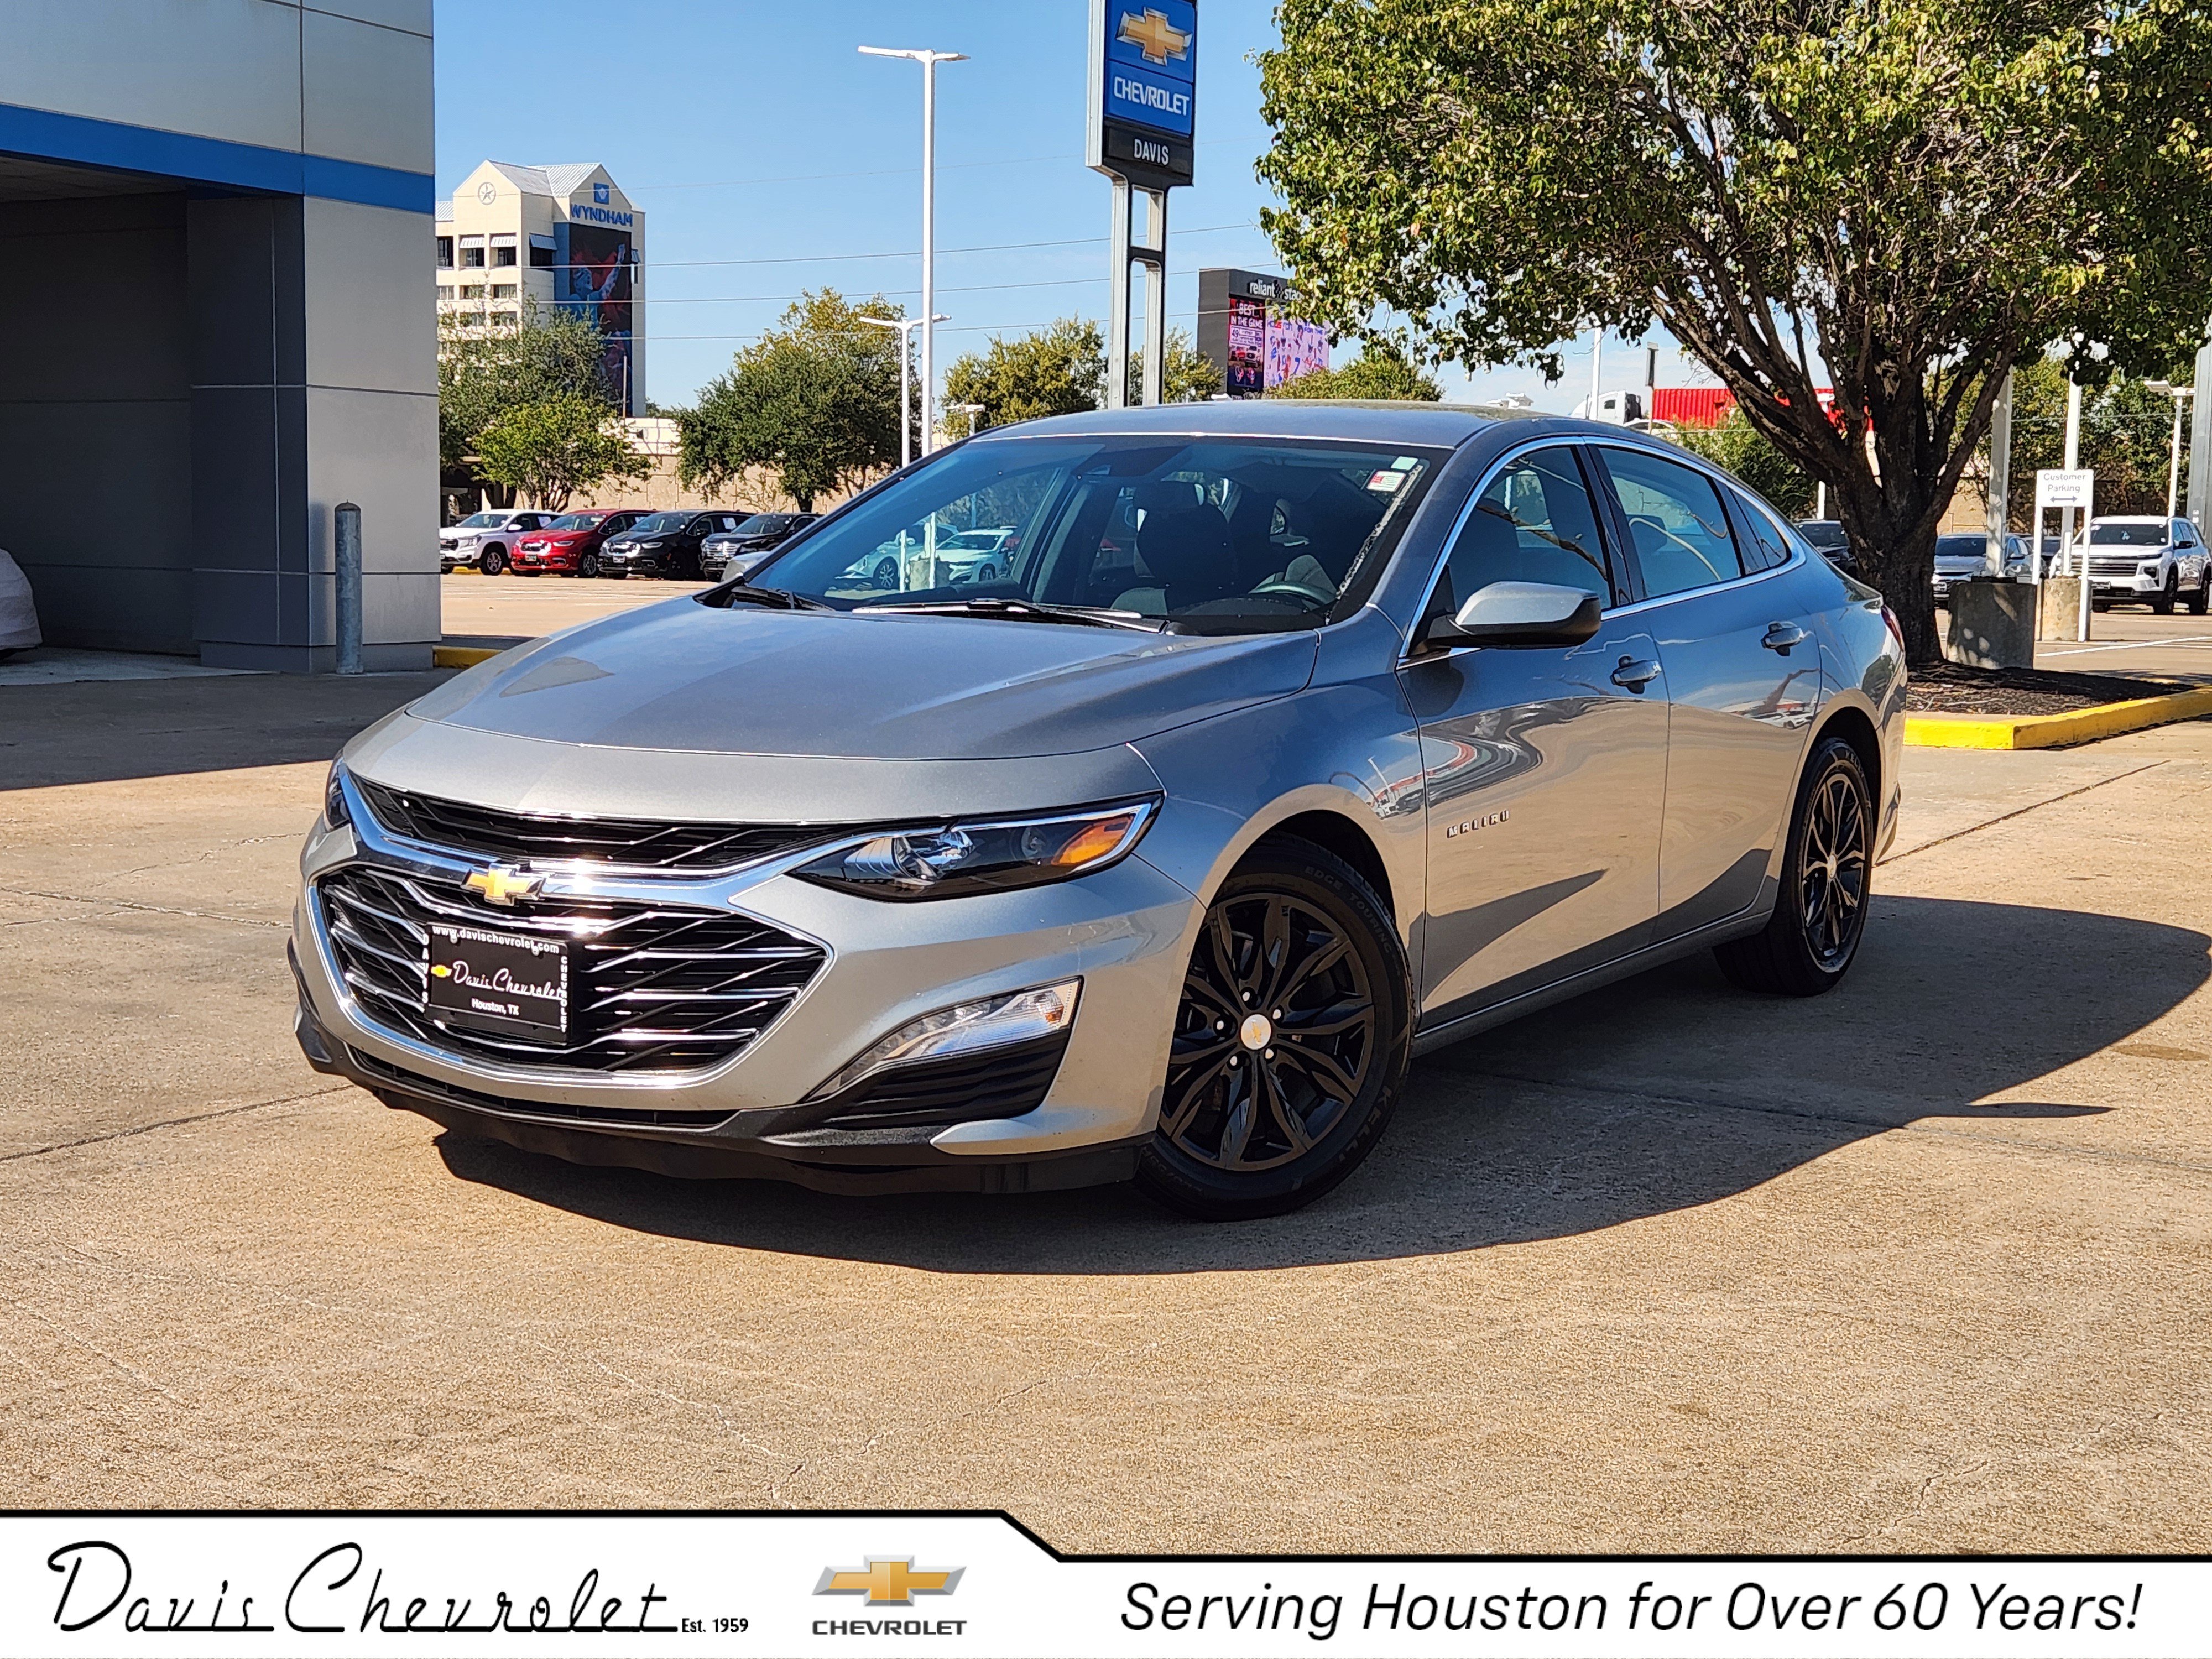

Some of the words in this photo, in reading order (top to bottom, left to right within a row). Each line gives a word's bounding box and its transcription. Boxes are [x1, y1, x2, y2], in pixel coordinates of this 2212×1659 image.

[1114, 76, 1190, 116] CHEVROLET
[1134, 139, 1169, 165] DAVIS
[570, 204, 633, 227] WYNDHAM
[1249, 279, 1276, 298] reliant
[1239, 302, 1259, 317] BEST
[1238, 316, 1248, 327] THE
[1248, 317, 1264, 330] GAME
[2048, 484, 2080, 493] Parking
[1447, 809, 1510, 839] MALIBU
[1304, 865, 1344, 891] EDGE
[1348, 892, 1392, 953] TOURING
[432, 926, 560, 954] www.davischevrolet.com
[452, 960, 493, 990] Davis
[492, 968, 563, 1001] Chevrolet
[471, 998, 507, 1015] Houston,
[507, 1004, 520, 1016] TX
[560, 956, 568, 1033] CHEVROLET
